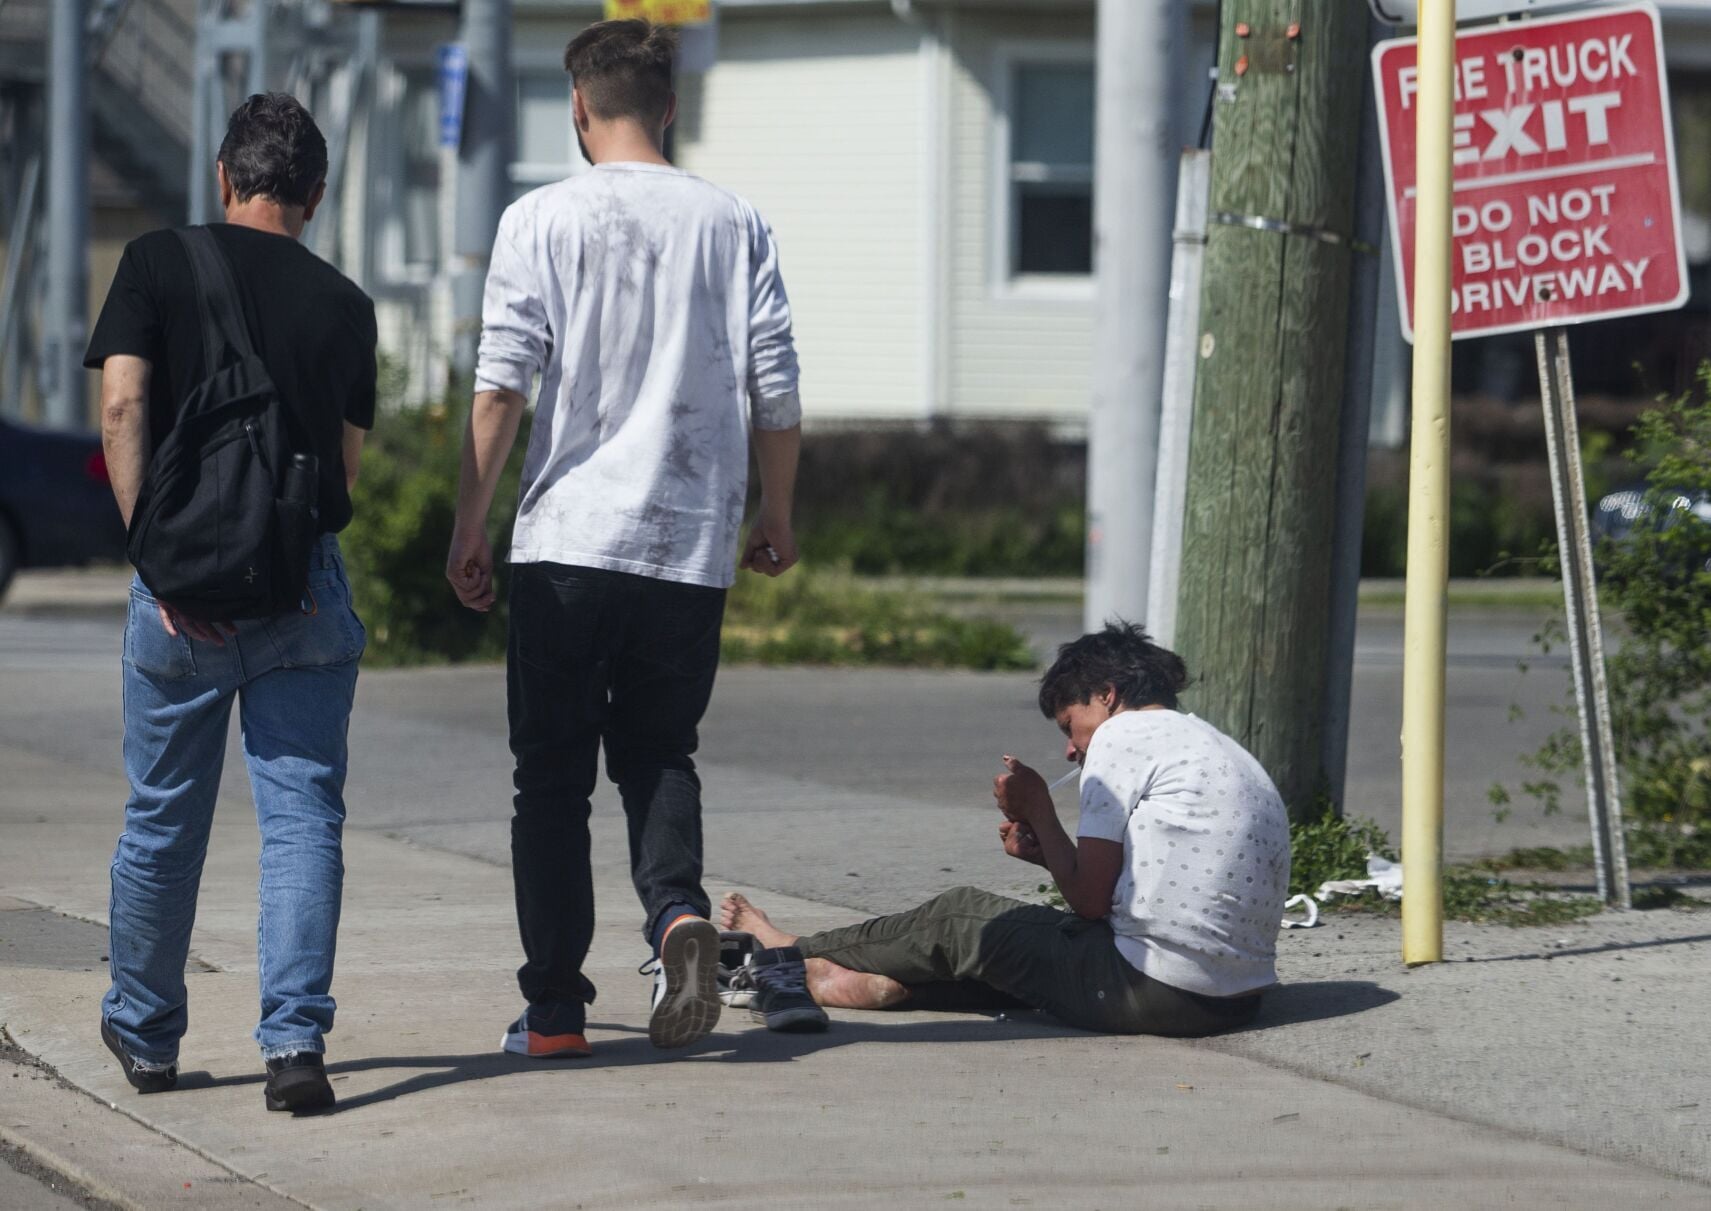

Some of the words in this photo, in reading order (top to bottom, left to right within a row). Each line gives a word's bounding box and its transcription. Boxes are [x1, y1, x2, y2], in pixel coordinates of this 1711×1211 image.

[1398, 56, 1488, 109] FE
[1496, 34, 1637, 94] TRUCK
[1453, 91, 1621, 165] EXIT
[1453, 200, 1513, 237] DO
[1527, 185, 1616, 226] NOT
[1462, 224, 1613, 274] BLOCK
